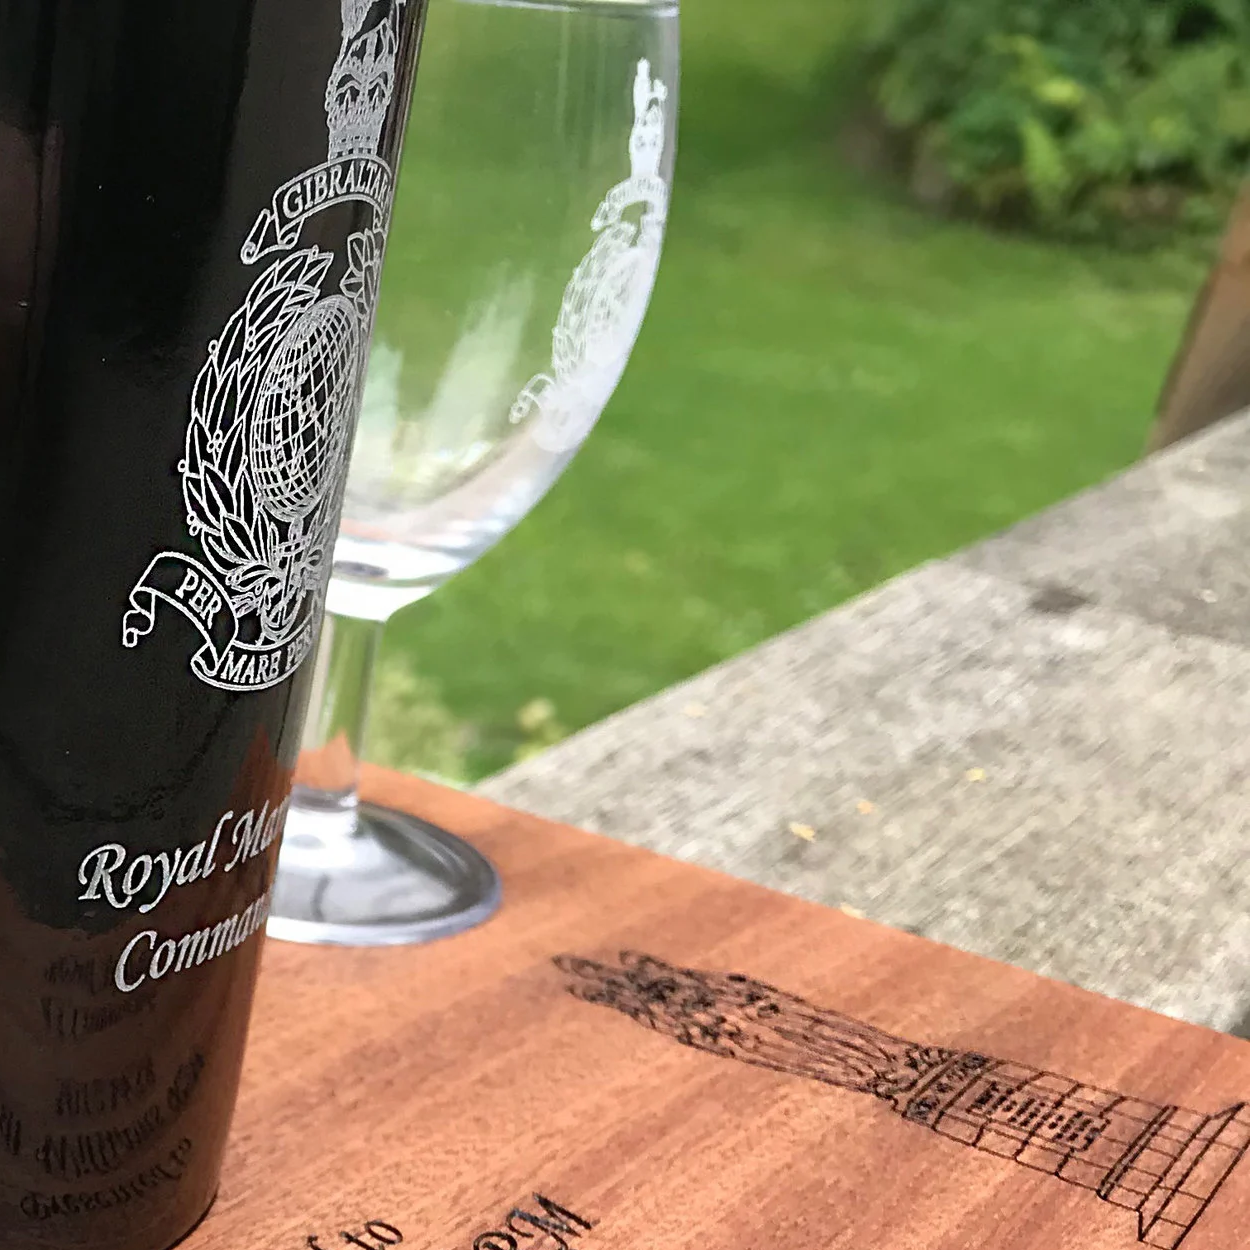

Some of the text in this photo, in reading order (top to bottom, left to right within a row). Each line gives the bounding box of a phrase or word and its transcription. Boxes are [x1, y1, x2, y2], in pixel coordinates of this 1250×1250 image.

[282, 160, 388, 219] GIBRALTAR
[175, 567, 223, 630] PER
[220, 649, 283, 685] MARE
[77, 809, 234, 914] Royal
